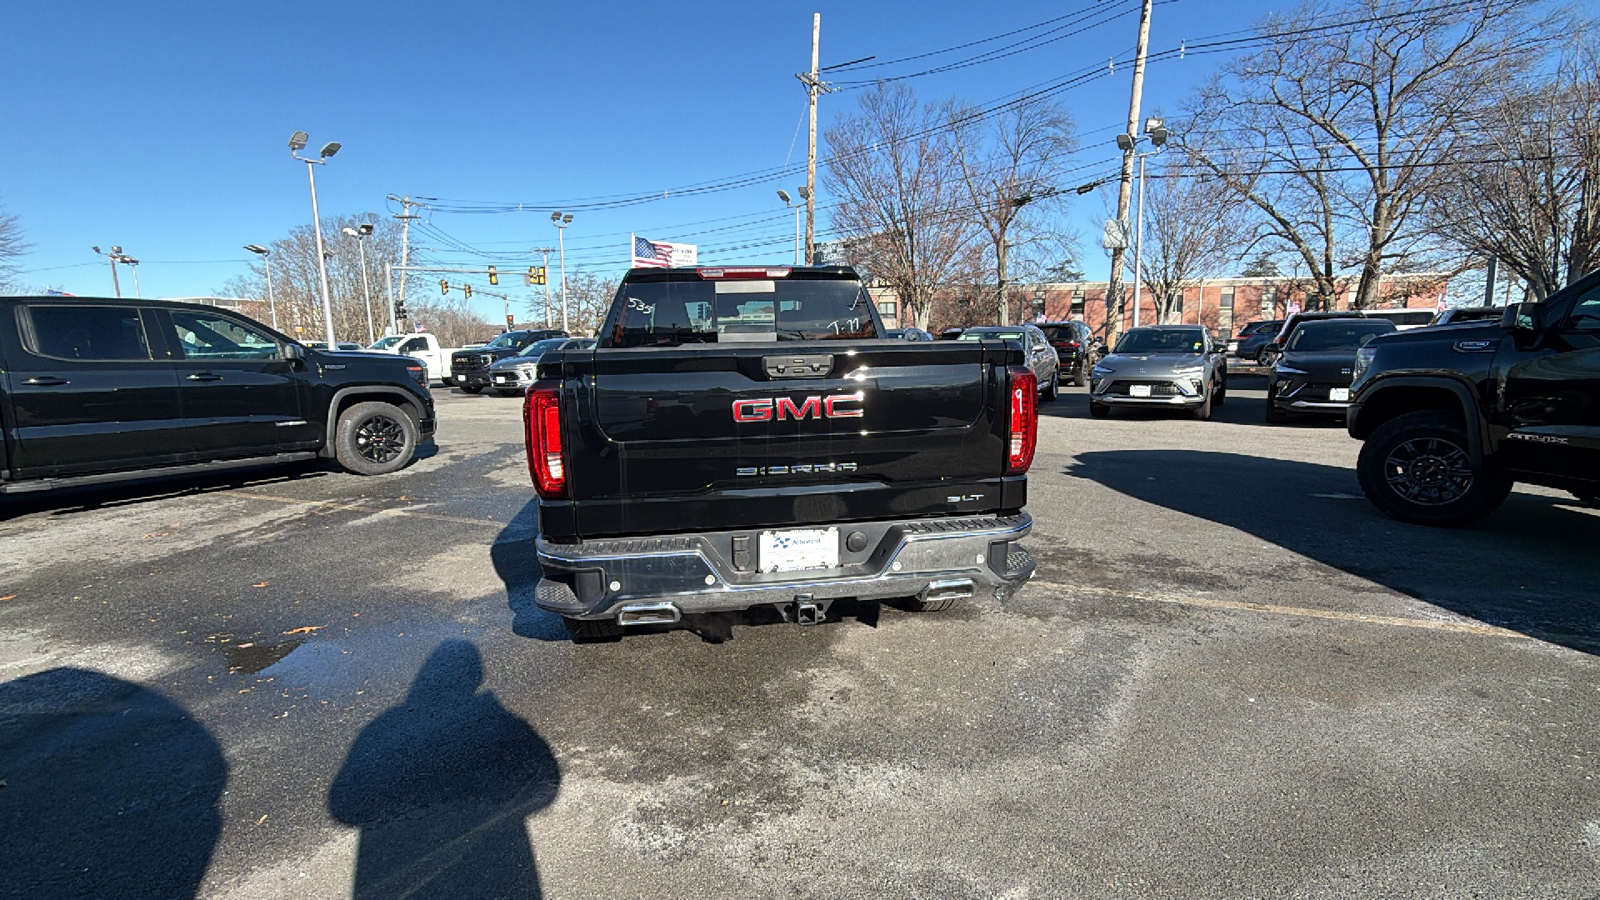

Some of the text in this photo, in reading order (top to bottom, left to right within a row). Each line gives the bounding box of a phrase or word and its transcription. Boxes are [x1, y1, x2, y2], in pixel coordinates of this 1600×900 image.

[732, 391, 864, 422] GMC
[1506, 432, 1569, 446] AT4X
[736, 462, 858, 476] SIERRA
[947, 494, 985, 503] SLT
[792, 537, 822, 546] Albrecht
